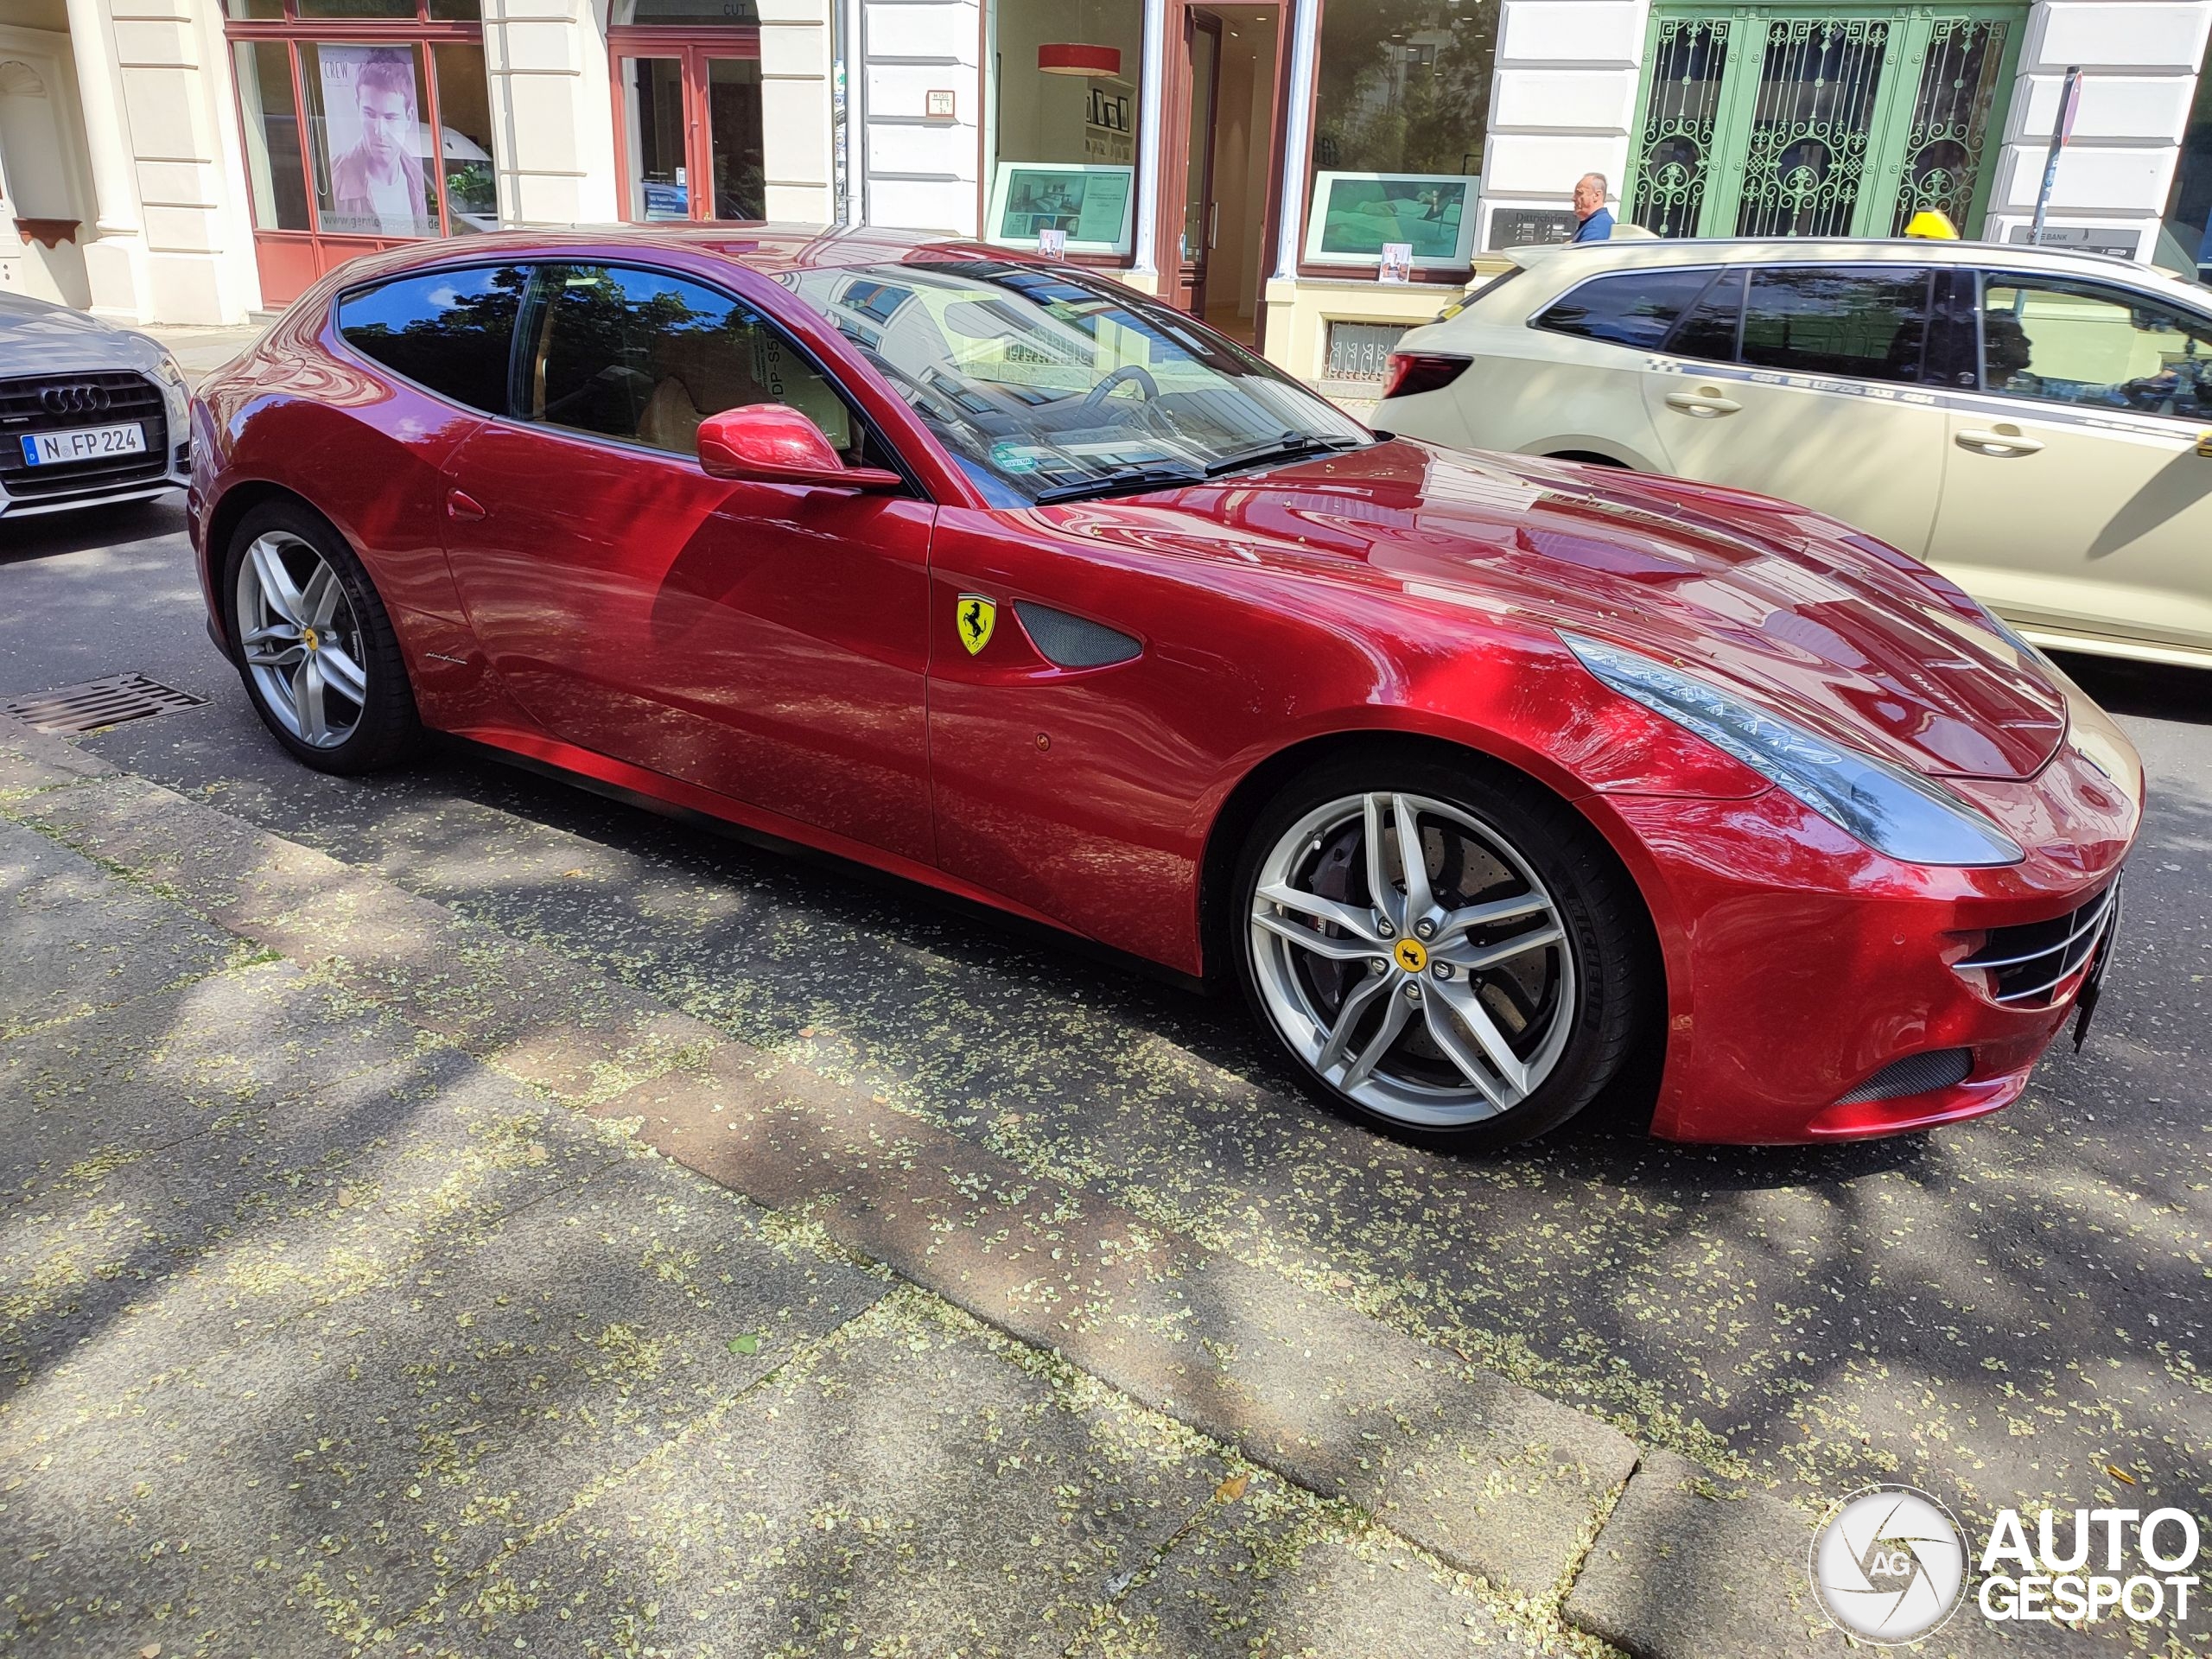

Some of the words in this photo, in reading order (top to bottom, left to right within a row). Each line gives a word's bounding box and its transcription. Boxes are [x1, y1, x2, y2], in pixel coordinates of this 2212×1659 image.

[723, 3, 747, 16] CUT
[324, 60, 347, 79] CREW
[1516, 212, 1568, 223] Dittrichring
[1813, 380, 1862, 394] LEIPZIG
[1865, 387, 1896, 399] TAXI
[44, 436, 60, 459] N
[71, 434, 98, 455] FP
[101, 429, 137, 452] 224
